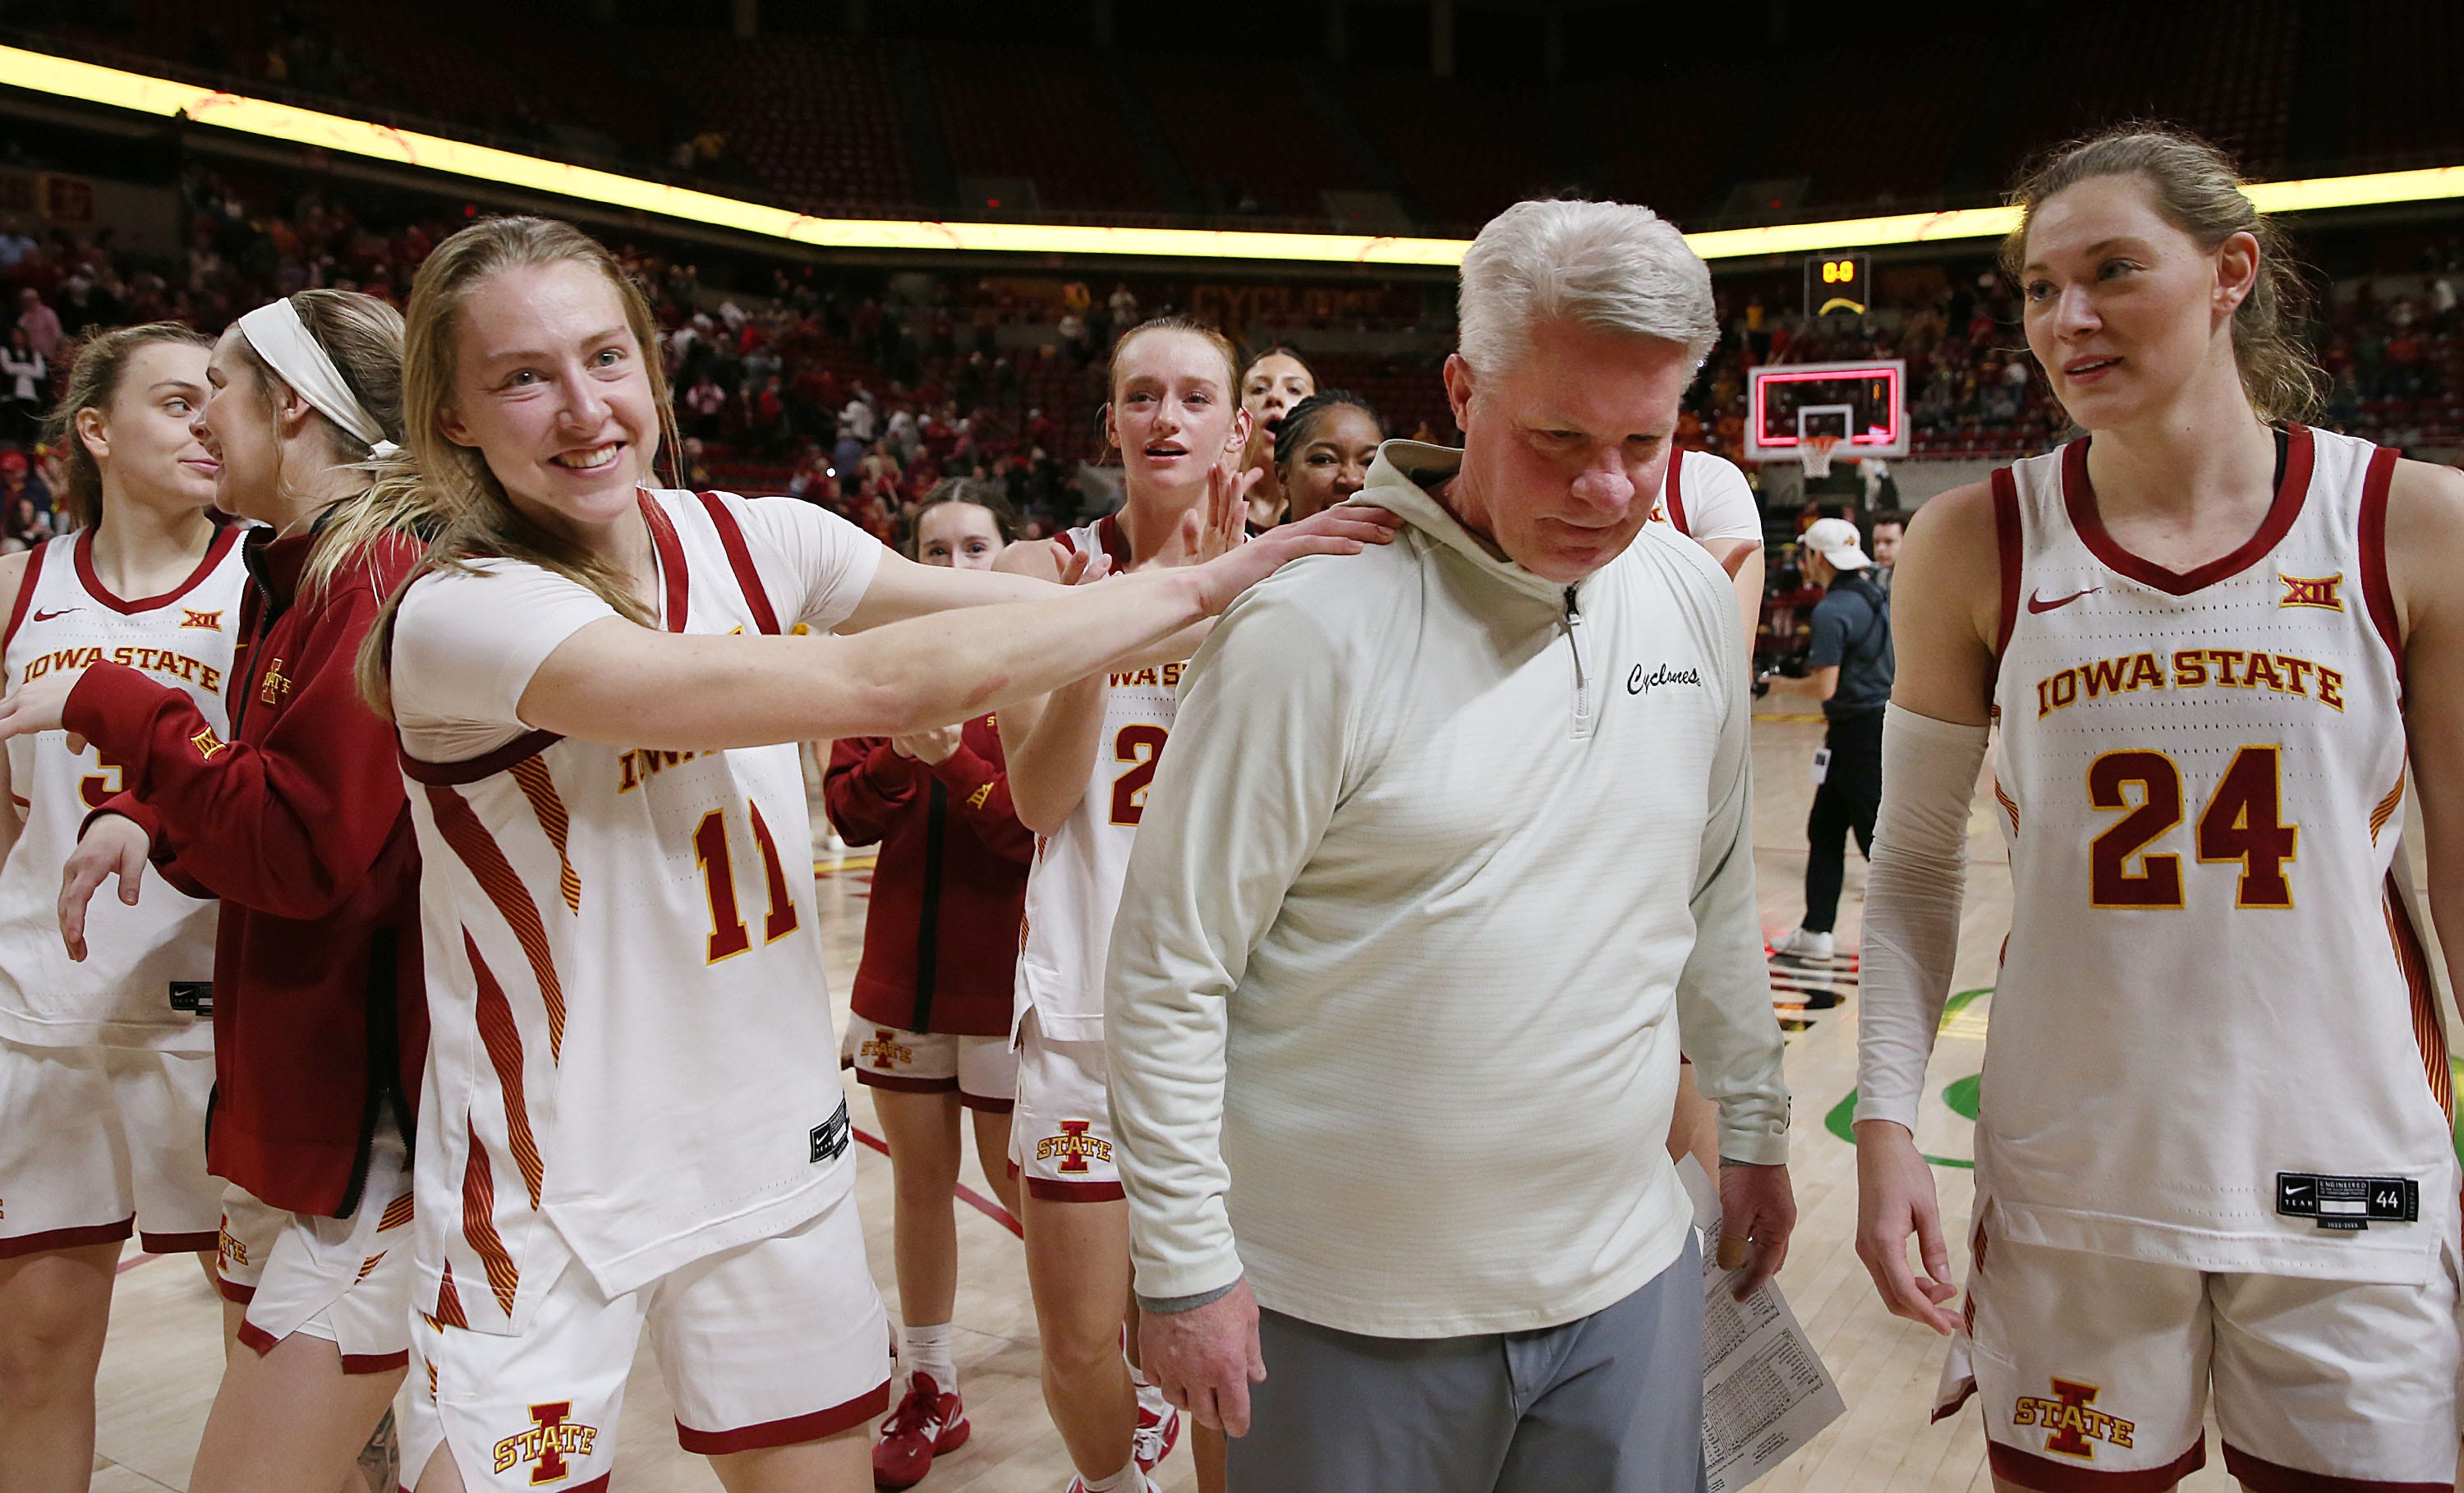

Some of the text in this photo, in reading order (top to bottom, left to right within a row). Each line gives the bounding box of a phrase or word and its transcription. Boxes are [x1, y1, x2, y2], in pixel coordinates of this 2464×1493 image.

[23, 646, 222, 696] IOWA STATE
[1627, 663, 1699, 696] Cyclones
[2037, 649, 2346, 721] IOWA STATE
[2087, 744, 2299, 909] 24
[692, 797, 800, 966] 11
[860, 1041, 913, 1064] STATE
[1037, 1136, 1112, 1163] STATE
[2376, 1190, 2398, 1209] 44
[2013, 1396, 2135, 1449] STATE
[493, 1423, 598, 1474] STATE
